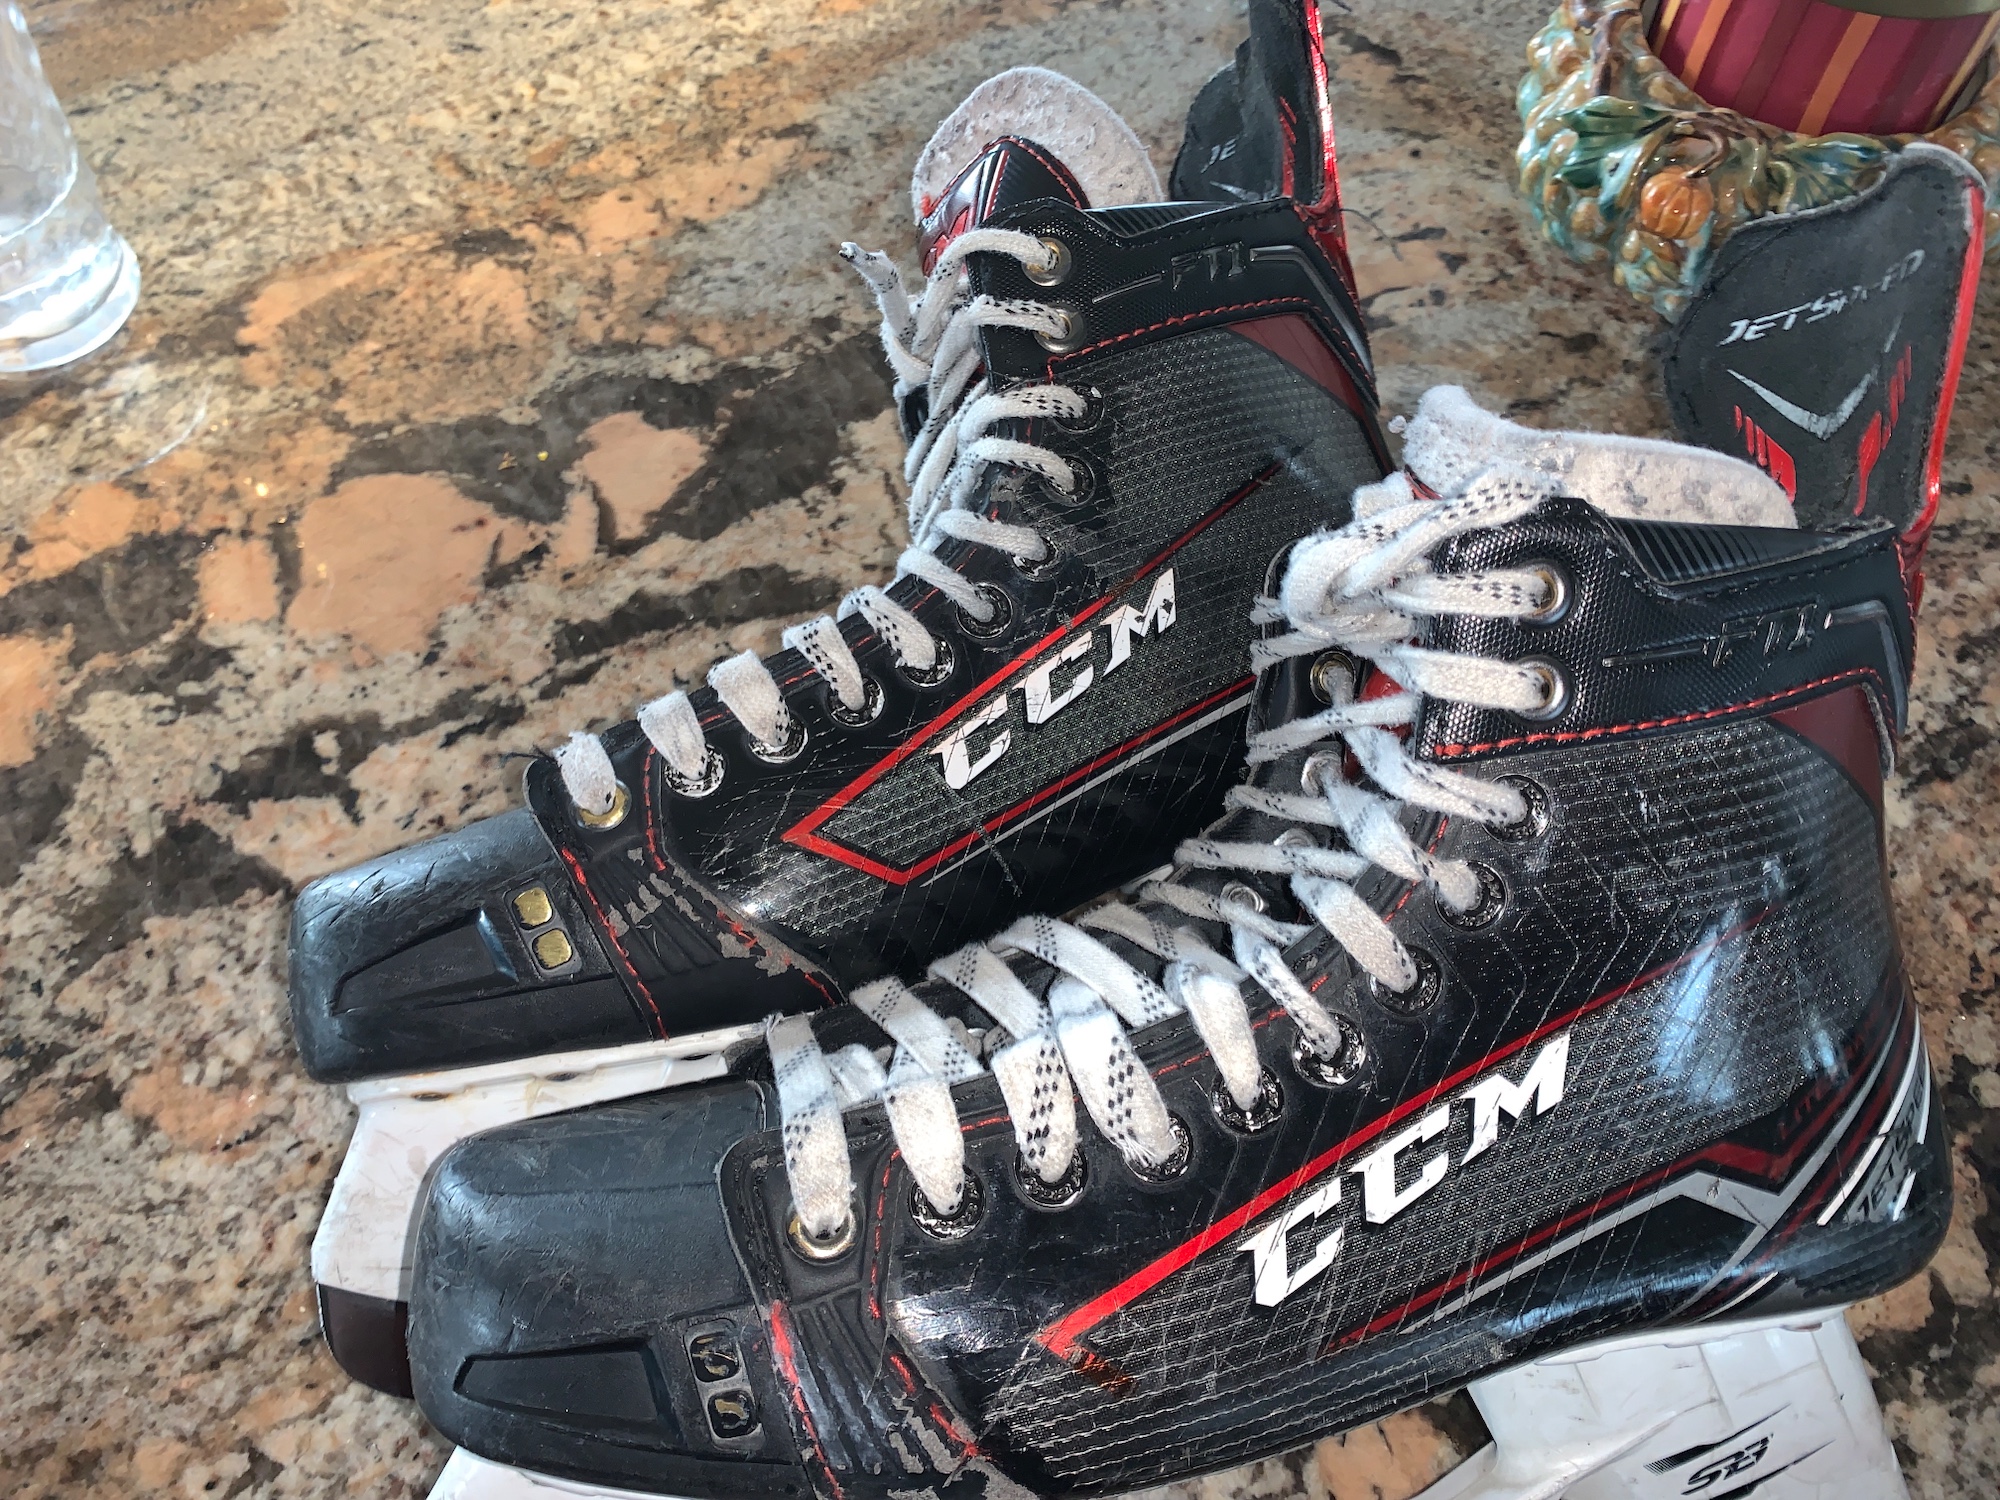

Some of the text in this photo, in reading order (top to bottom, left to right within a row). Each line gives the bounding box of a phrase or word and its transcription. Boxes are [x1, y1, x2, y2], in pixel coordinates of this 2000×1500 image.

[1716, 249, 1926, 346] JETSED
[929, 567, 1178, 791] CCM
[1236, 1033, 1571, 1308] CCM
